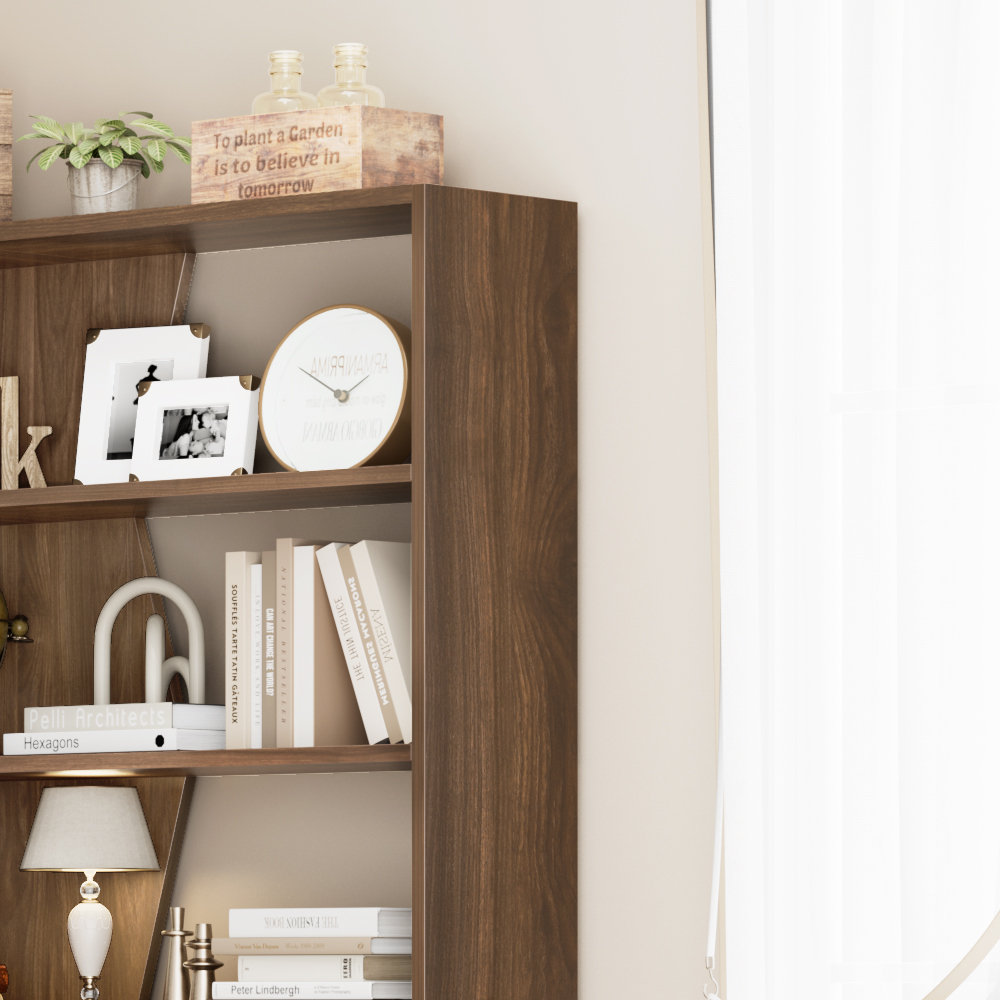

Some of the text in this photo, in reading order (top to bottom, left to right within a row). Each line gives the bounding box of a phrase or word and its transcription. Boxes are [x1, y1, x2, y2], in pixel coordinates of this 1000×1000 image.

[213, 122, 343, 151] To plant a Garden
[214, 148, 340, 176] is to believe in
[238, 178, 314, 200] tomorrow
[231, 584, 239, 625] SOUFFLÉS
[265, 608, 274, 621] CAN
[265, 622, 274, 633] ART
[265, 634, 274, 658] CHANGE
[265, 659, 274, 672] THE
[29, 706, 165, 730] Pelli Architects
[24, 736, 80, 752] Hexagons
[231, 984, 300, 997] Peter Lindbergh
